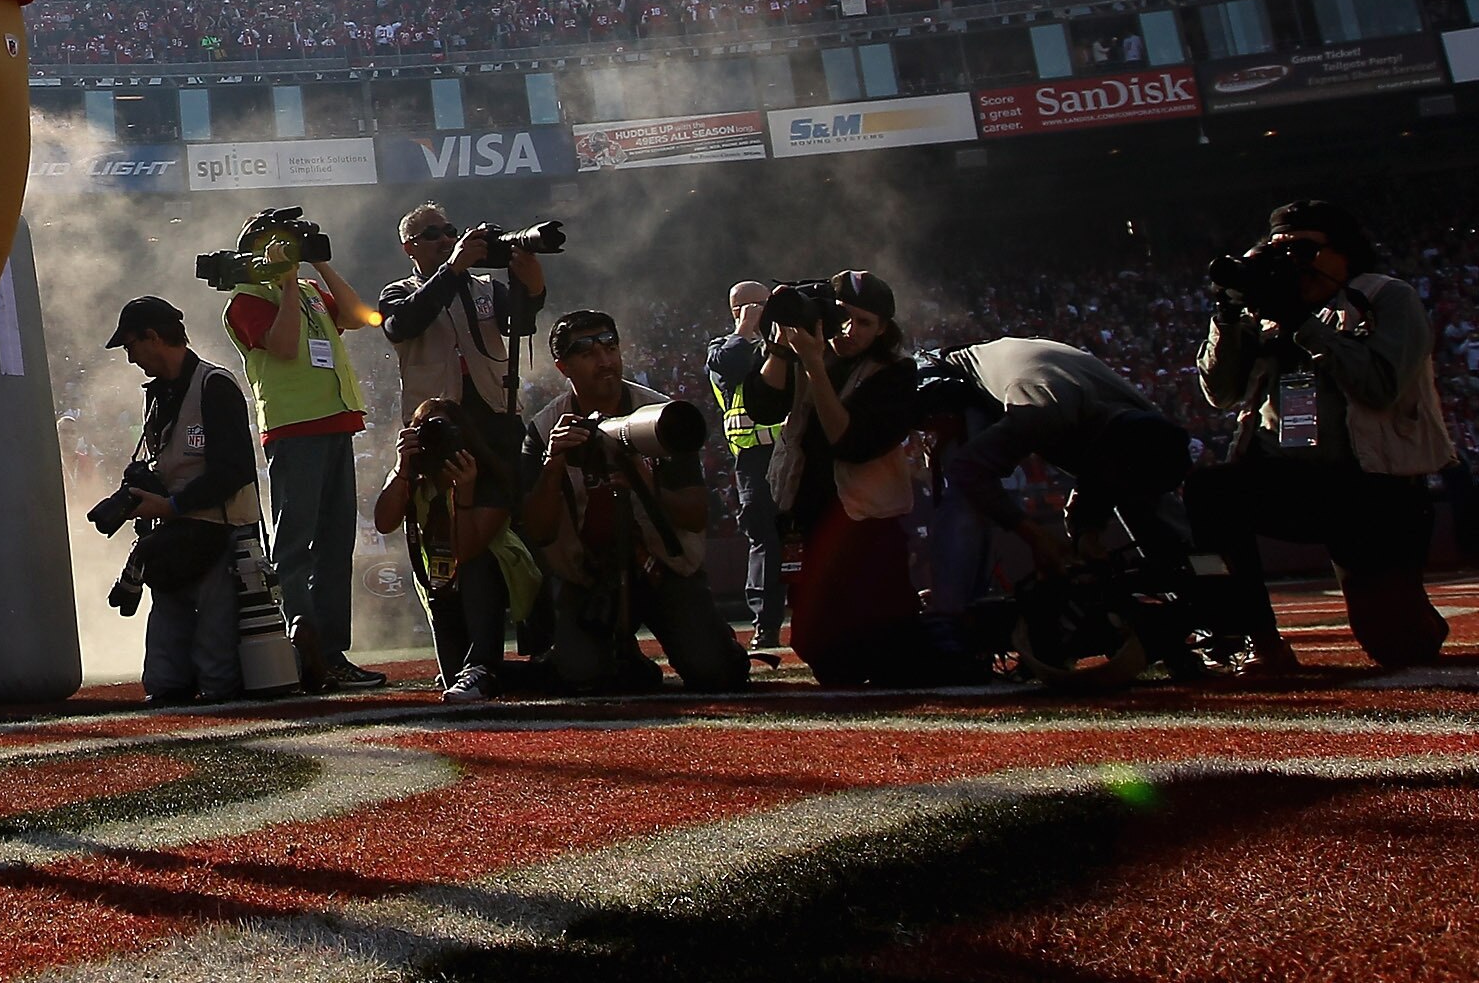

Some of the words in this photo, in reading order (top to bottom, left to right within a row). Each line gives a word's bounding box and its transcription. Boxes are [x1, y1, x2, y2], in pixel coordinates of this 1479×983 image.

[980, 94, 1015, 106] Score
[1035, 74, 1194, 115] SanDisk
[979, 112, 986, 120] a
[989, 107, 1023, 122] great
[615, 126, 657, 140] HUDDLE
[660, 124, 674, 134] UP
[674, 123, 692, 132] with
[693, 121, 706, 130] the
[790, 113, 862, 141] S&M
[983, 120, 1024, 133] career.
[635, 133, 669, 146] 49ERS
[671, 130, 691, 141] ALL
[692, 125, 735, 139] SEASON
[790, 138, 831, 147] MOVING
[835, 133, 885, 143] SYSTEMS
[289, 157, 324, 166] Network
[327, 155, 367, 164] Solutions
[421, 132, 542, 178] VISA
[88, 160, 177, 176] LIGHT
[197, 154, 267, 182] splice
[289, 165, 332, 174] Simplified
